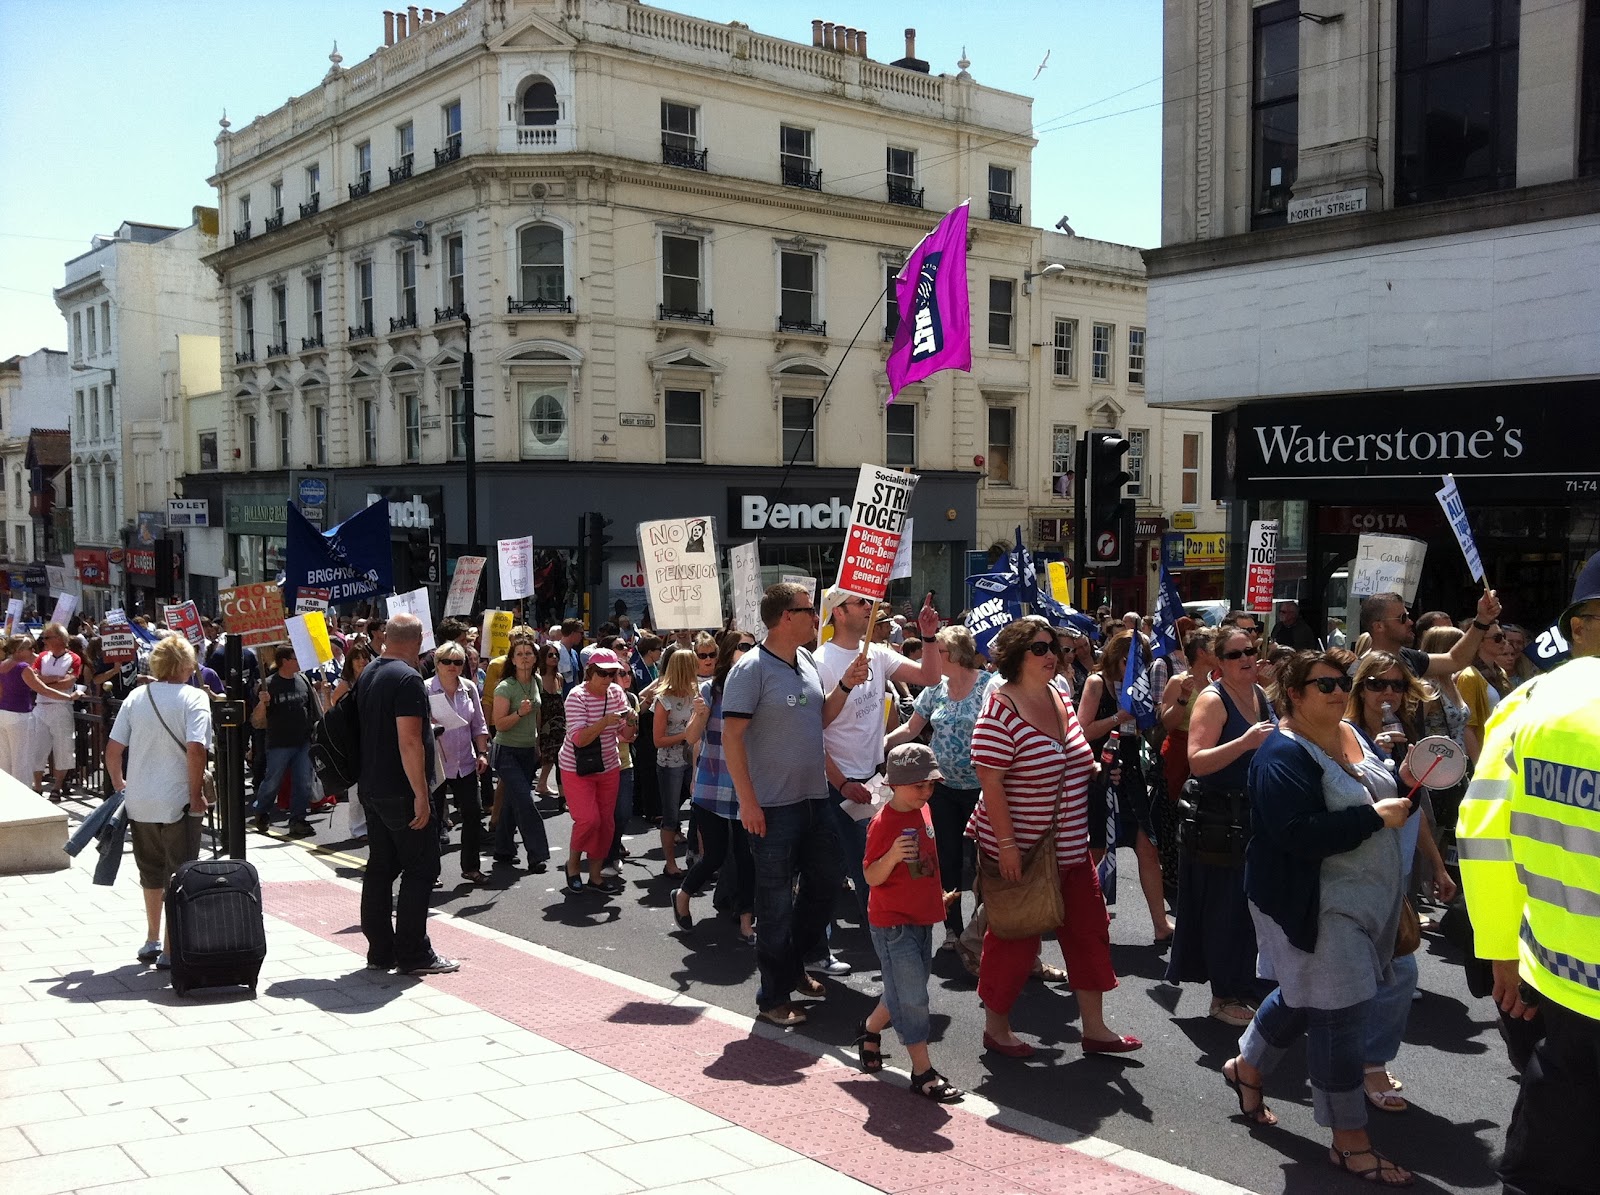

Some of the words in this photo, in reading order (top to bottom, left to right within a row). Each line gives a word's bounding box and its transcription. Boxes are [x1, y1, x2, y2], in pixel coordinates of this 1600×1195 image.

[1290, 207, 1322, 221] NORTH
[1327, 199, 1363, 215] STREET
[1253, 415, 1523, 465] Waterstone's
[875, 471, 908, 486] Socialist
[1565, 480, 1598, 492] 71-74
[872, 482, 911, 511] STRI
[856, 501, 907, 533] TOGET
[1352, 514, 1407, 529] COSTA
[649, 524, 685, 546] NO
[1134, 521, 1157, 535] hina
[861, 530, 883, 546] Bring
[654, 547, 678, 562] TO
[1361, 544, 1375, 561] I
[856, 555, 874, 570] TUC:
[620, 574, 645, 588] CLO
[655, 563, 717, 583] PENSION
[852, 569, 883, 584] general
[1357, 569, 1371, 587] My
[219, 591, 236, 601] SAY
[236, 584, 265, 599] NO
[264, 585, 278, 593] TO
[658, 584, 702, 604] CUTS
[305, 599, 319, 607] FAIR
